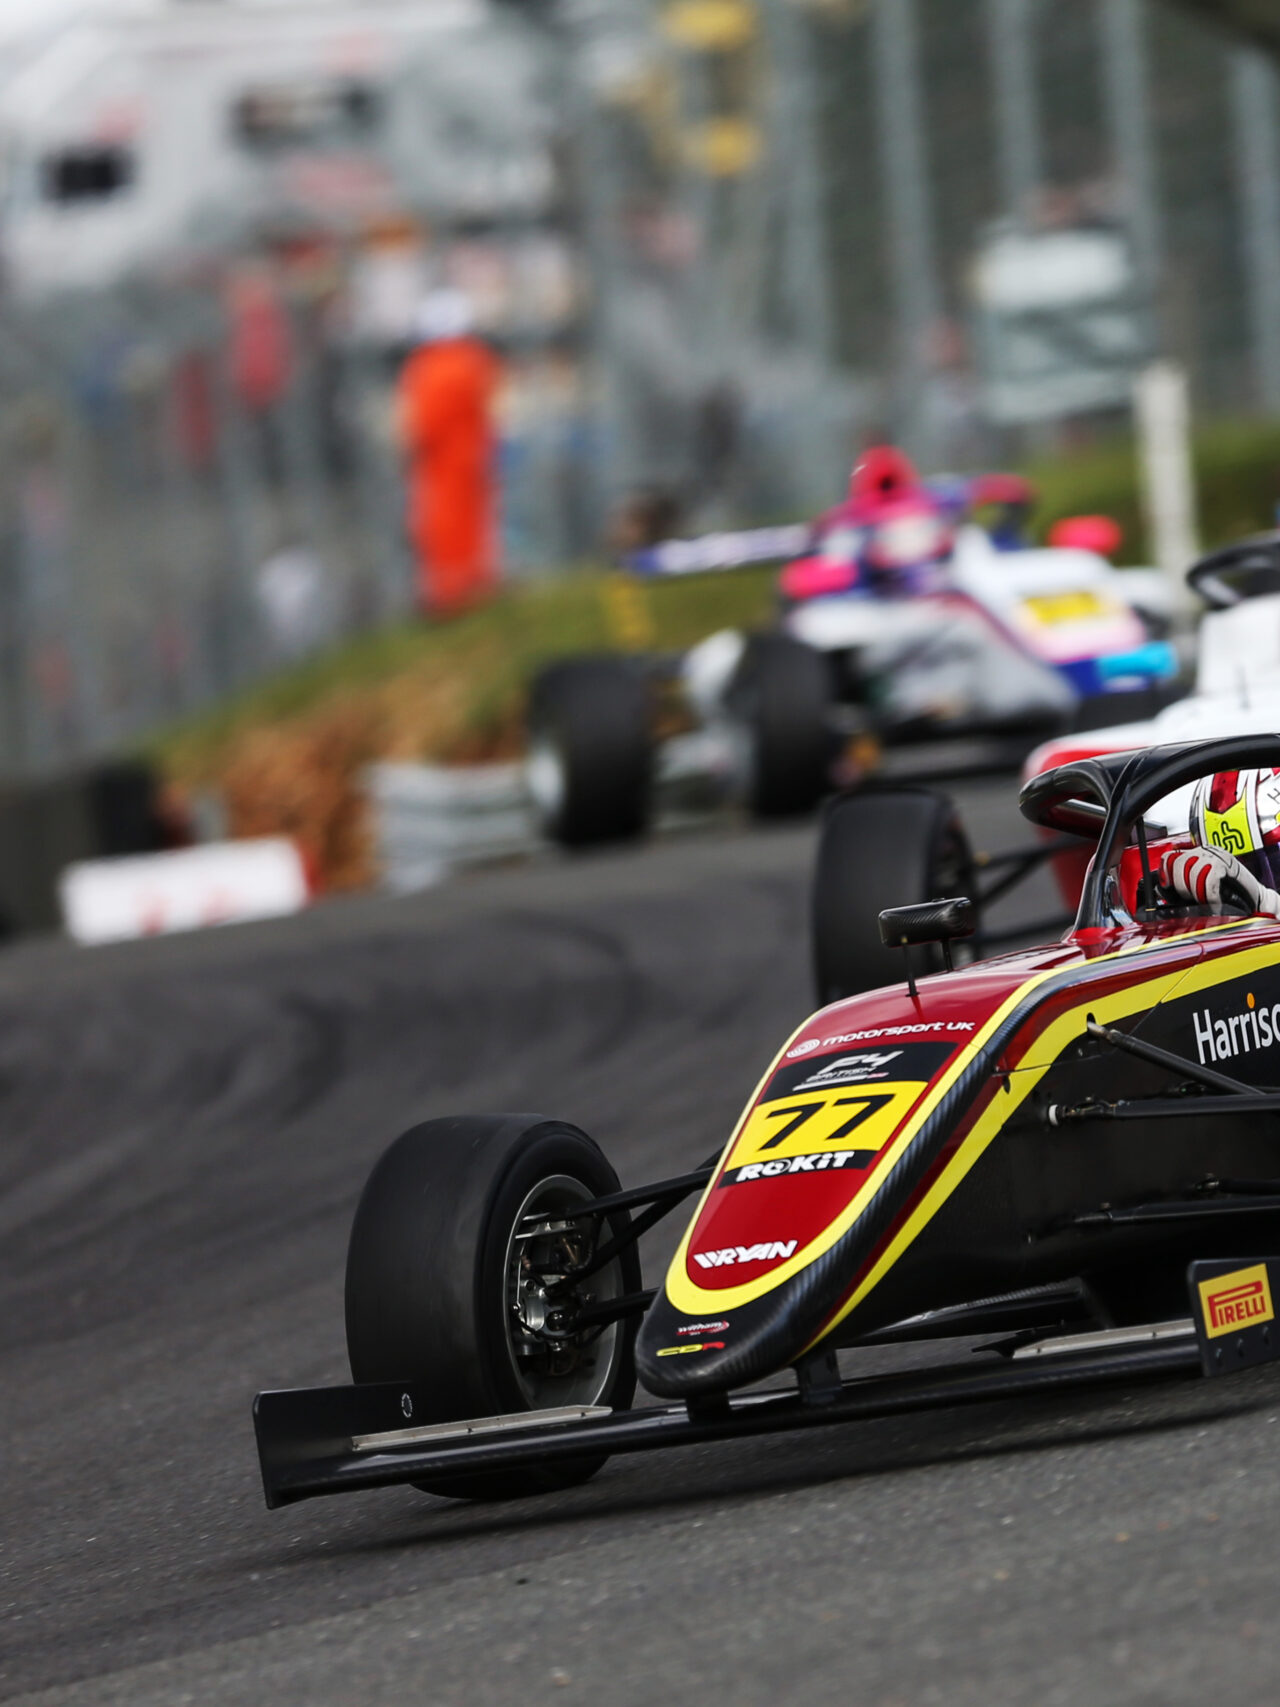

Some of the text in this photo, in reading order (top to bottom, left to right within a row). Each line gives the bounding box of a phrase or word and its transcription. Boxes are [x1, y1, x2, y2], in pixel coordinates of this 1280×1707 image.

[822, 1021, 945, 1047] motorsport
[756, 1093, 897, 1152] 77
[1207, 1280, 1267, 1328] PIRELLI
